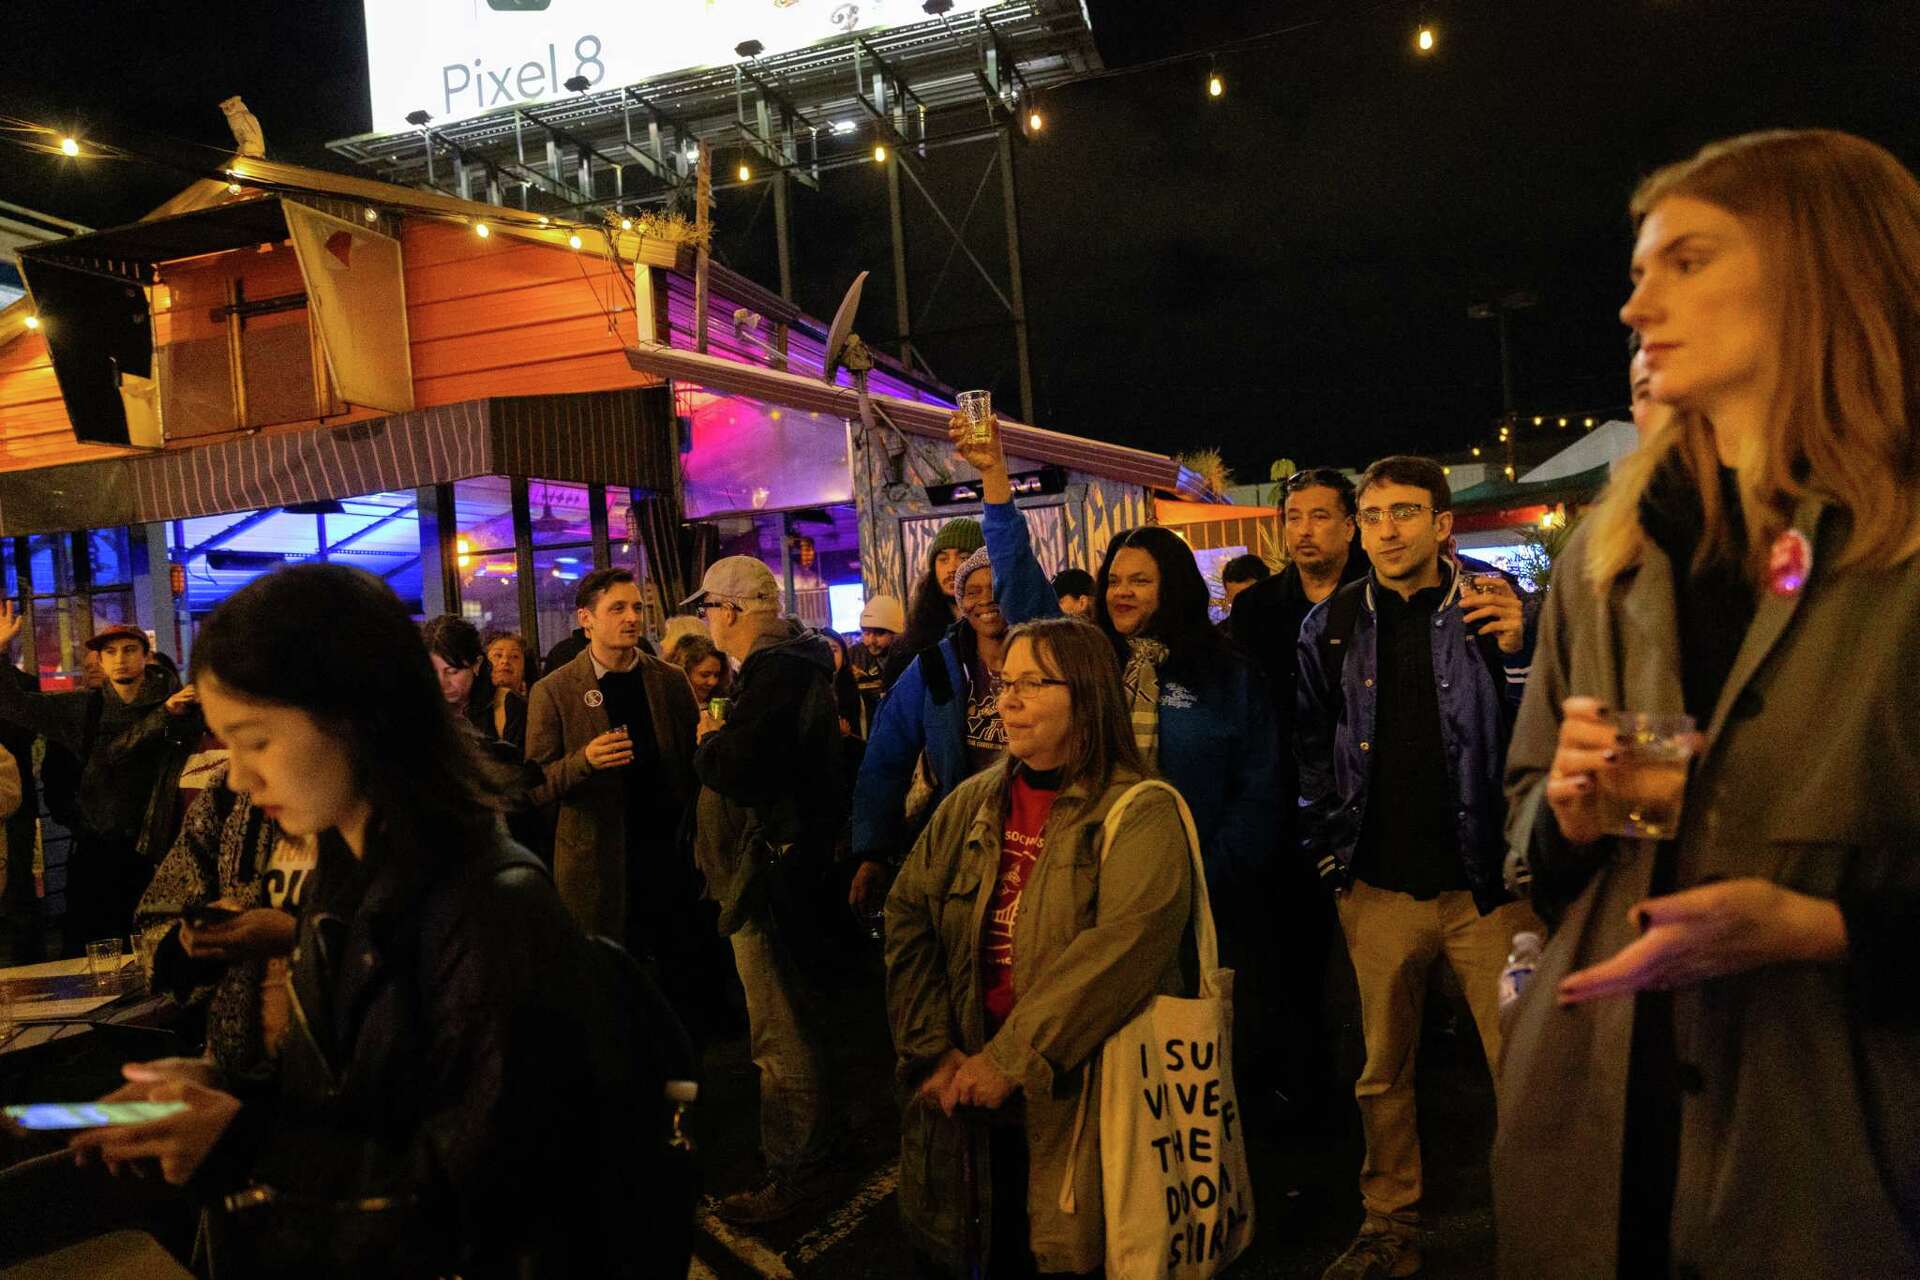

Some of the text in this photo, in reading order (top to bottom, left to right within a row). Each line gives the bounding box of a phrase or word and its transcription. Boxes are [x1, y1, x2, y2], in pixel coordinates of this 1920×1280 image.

[442, 34, 605, 115] Pixel 8
[950, 476, 1042, 501] AM
[1140, 1043, 1148, 1079] I
[1151, 1127, 1213, 1174] THE
